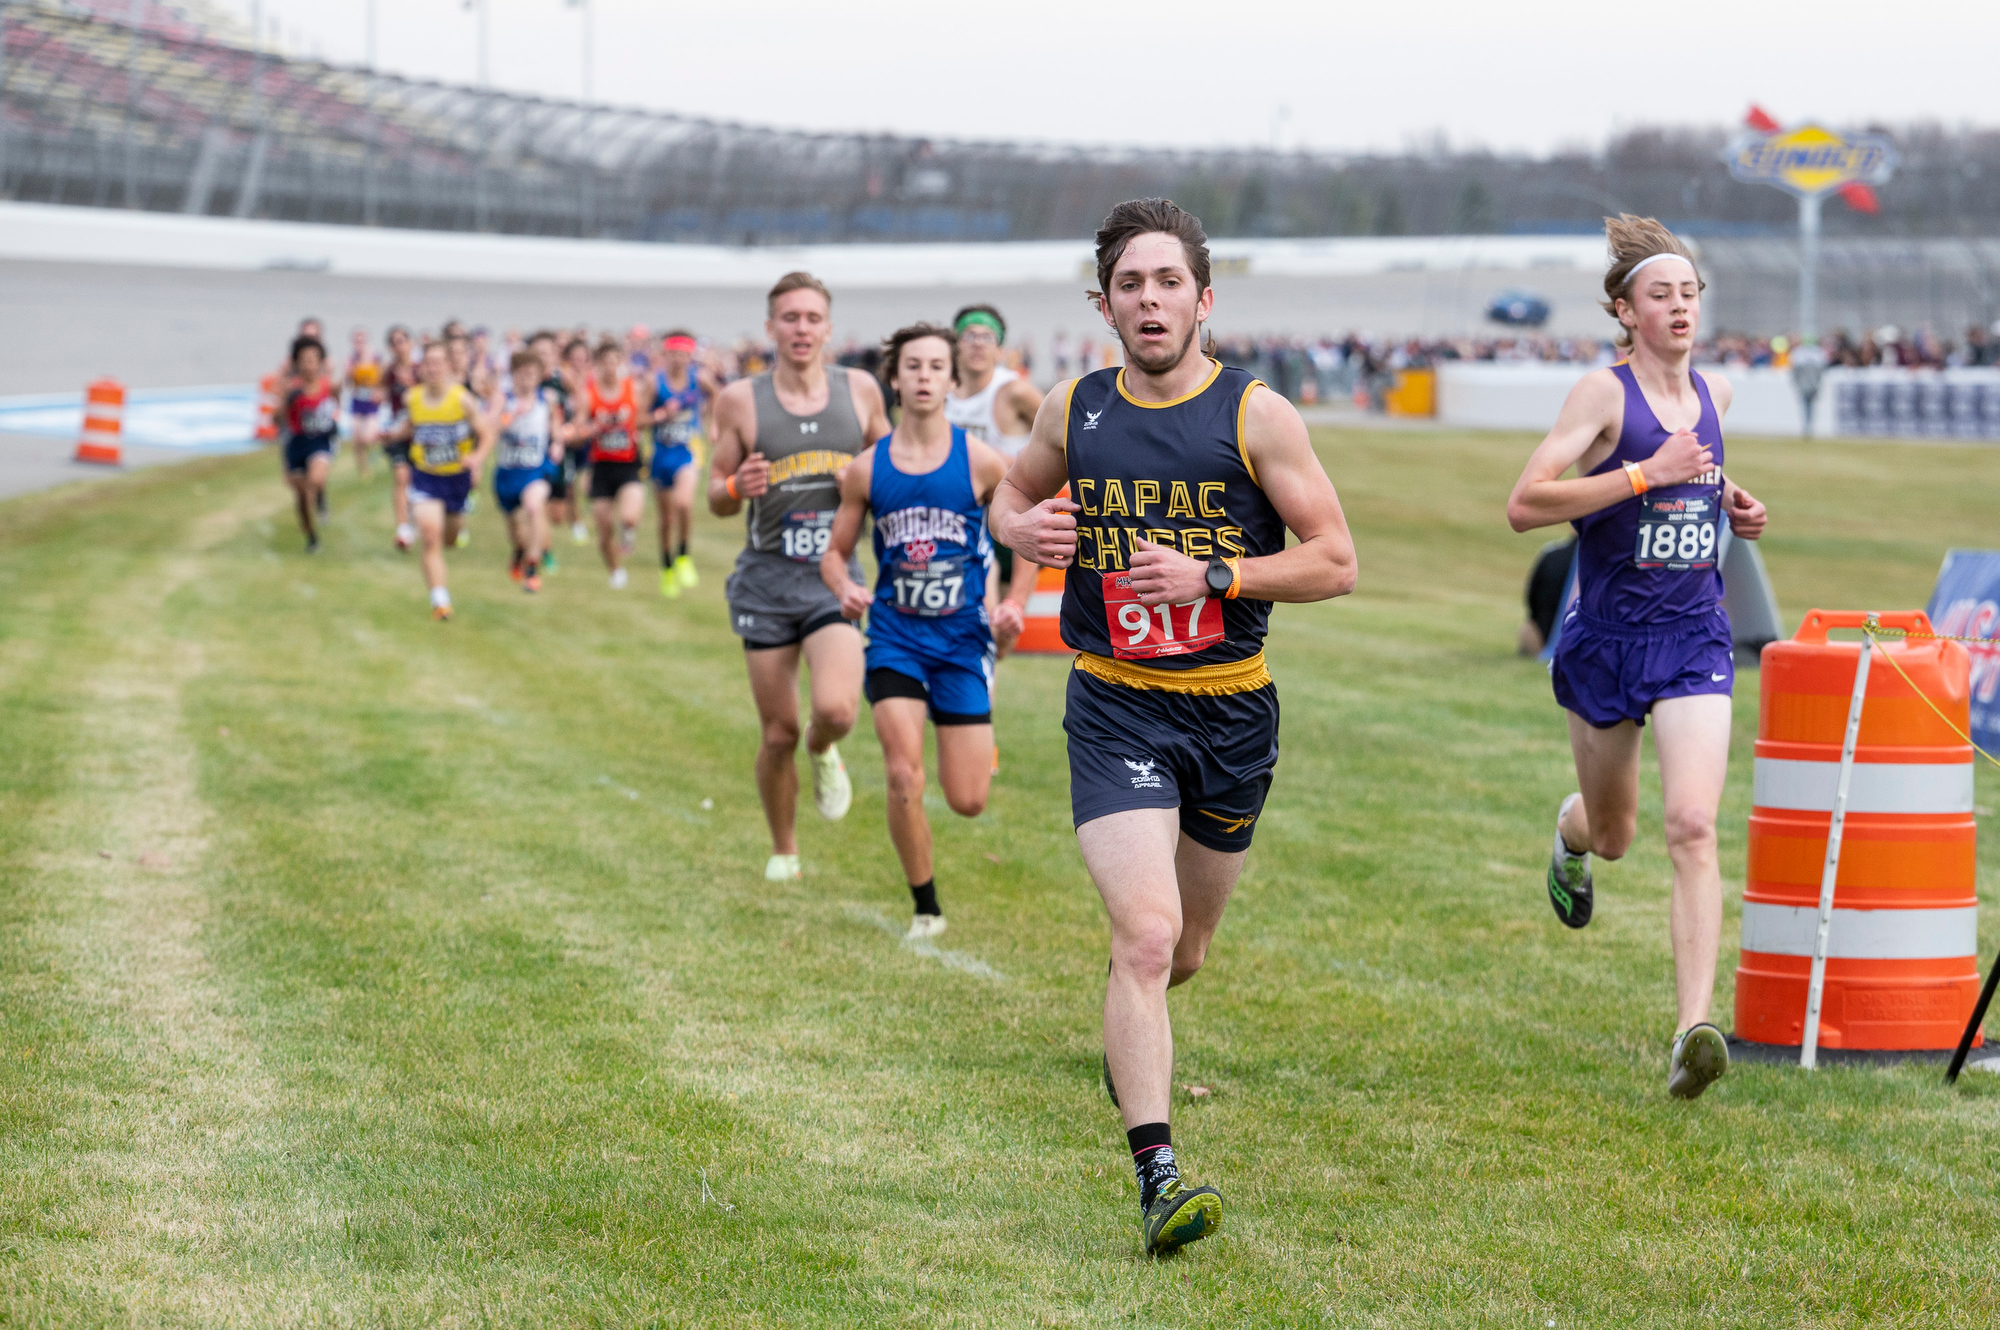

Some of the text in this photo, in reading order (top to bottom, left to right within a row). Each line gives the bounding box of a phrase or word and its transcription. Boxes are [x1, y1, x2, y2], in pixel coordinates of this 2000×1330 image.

[1077, 478, 1226, 518] CAPAC
[782, 527, 831, 556] 189
[877, 505, 967, 549] COUGARS
[1639, 522, 1715, 559] 1889
[893, 576, 963, 608] 1767
[1118, 596, 1206, 645] 917
